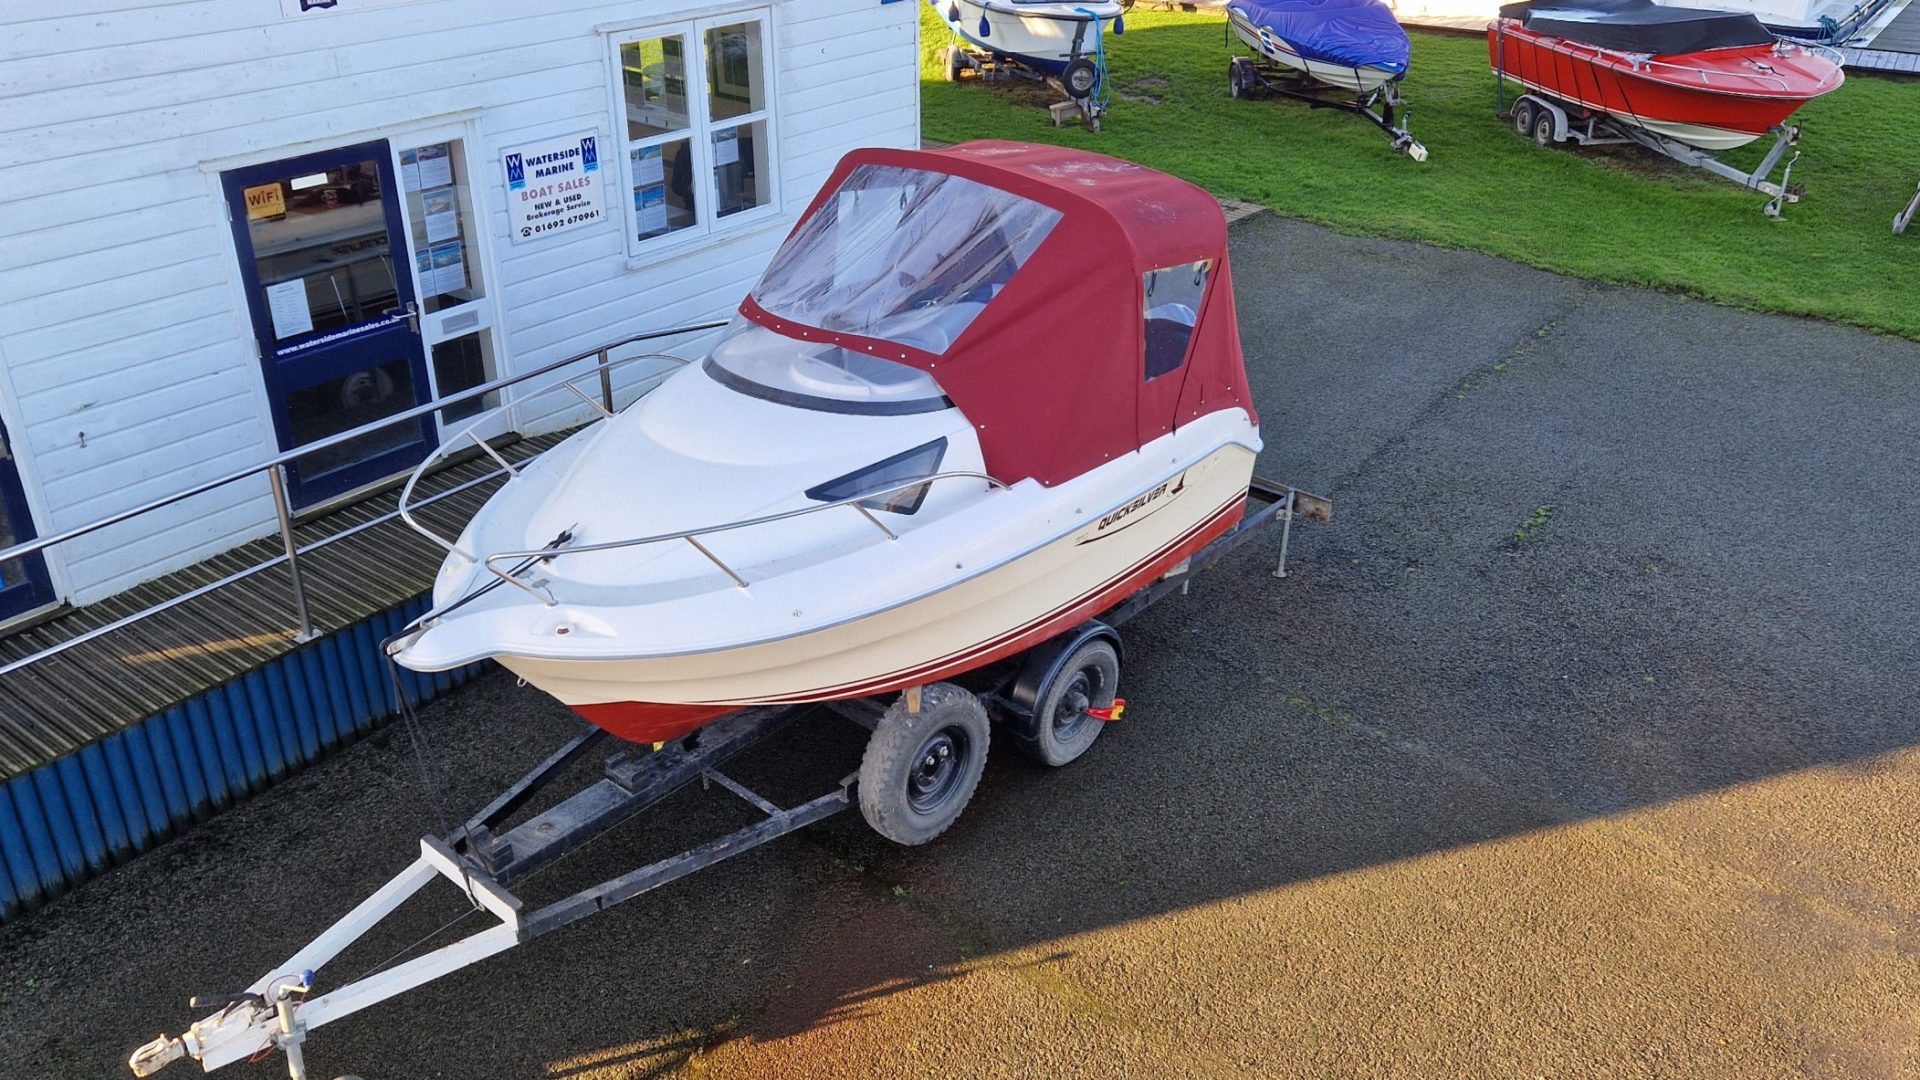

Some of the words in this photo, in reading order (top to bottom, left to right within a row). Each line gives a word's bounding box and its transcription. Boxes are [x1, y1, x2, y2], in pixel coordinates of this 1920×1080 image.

[525, 147, 580, 167] WATERSIDE
[535, 162, 574, 178] MARINE
[521, 186, 553, 201] BOAT
[558, 176, 591, 192] SALES
[526, 207, 564, 221] Brokerage
[566, 200, 591, 211] Service
[534, 200, 552, 211] NEW
[563, 193, 582, 204] USED
[535, 220, 564, 233] 01692
[567, 210, 600, 224] 670961
[1098, 483, 1168, 530] QUICKSILVER
